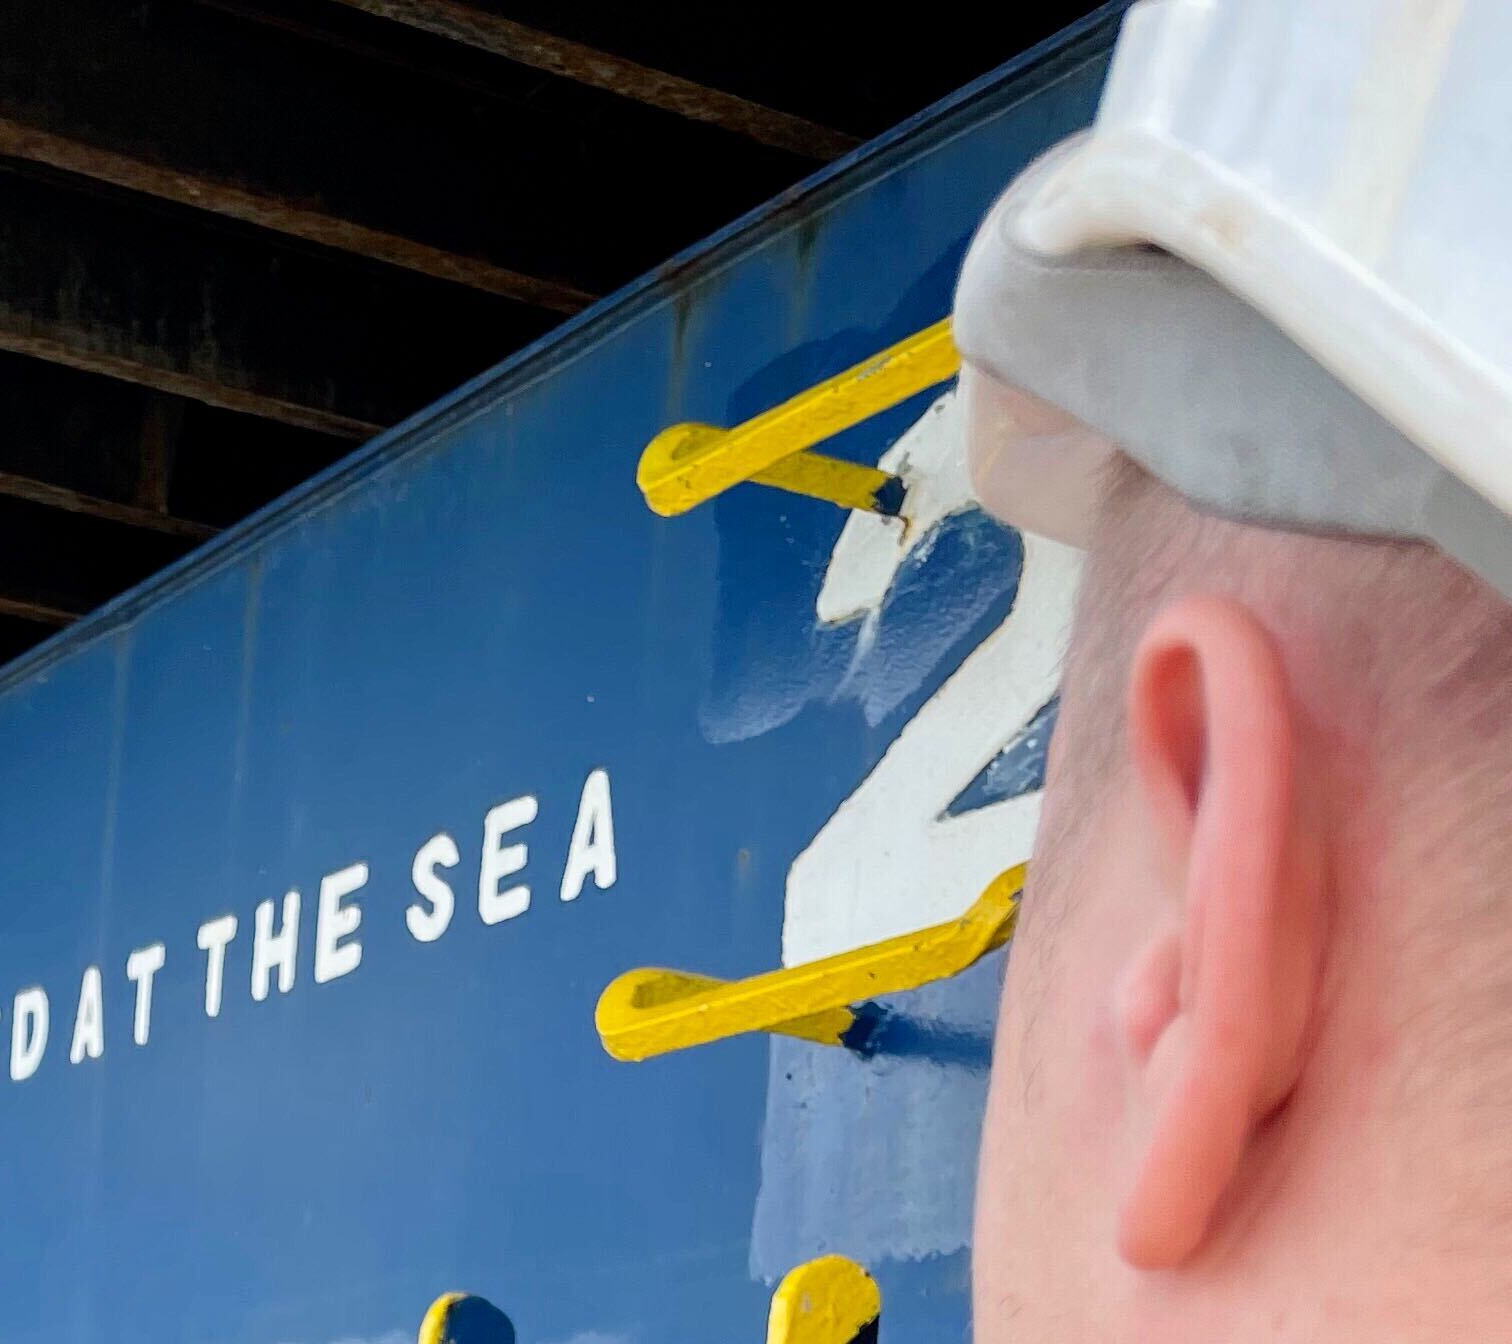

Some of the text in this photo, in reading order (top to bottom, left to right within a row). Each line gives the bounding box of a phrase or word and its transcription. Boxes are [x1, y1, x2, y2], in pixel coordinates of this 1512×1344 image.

[69, 942, 167, 1065] AT
[197, 861, 369, 1018] THE
[406, 767, 617, 943] SEA
